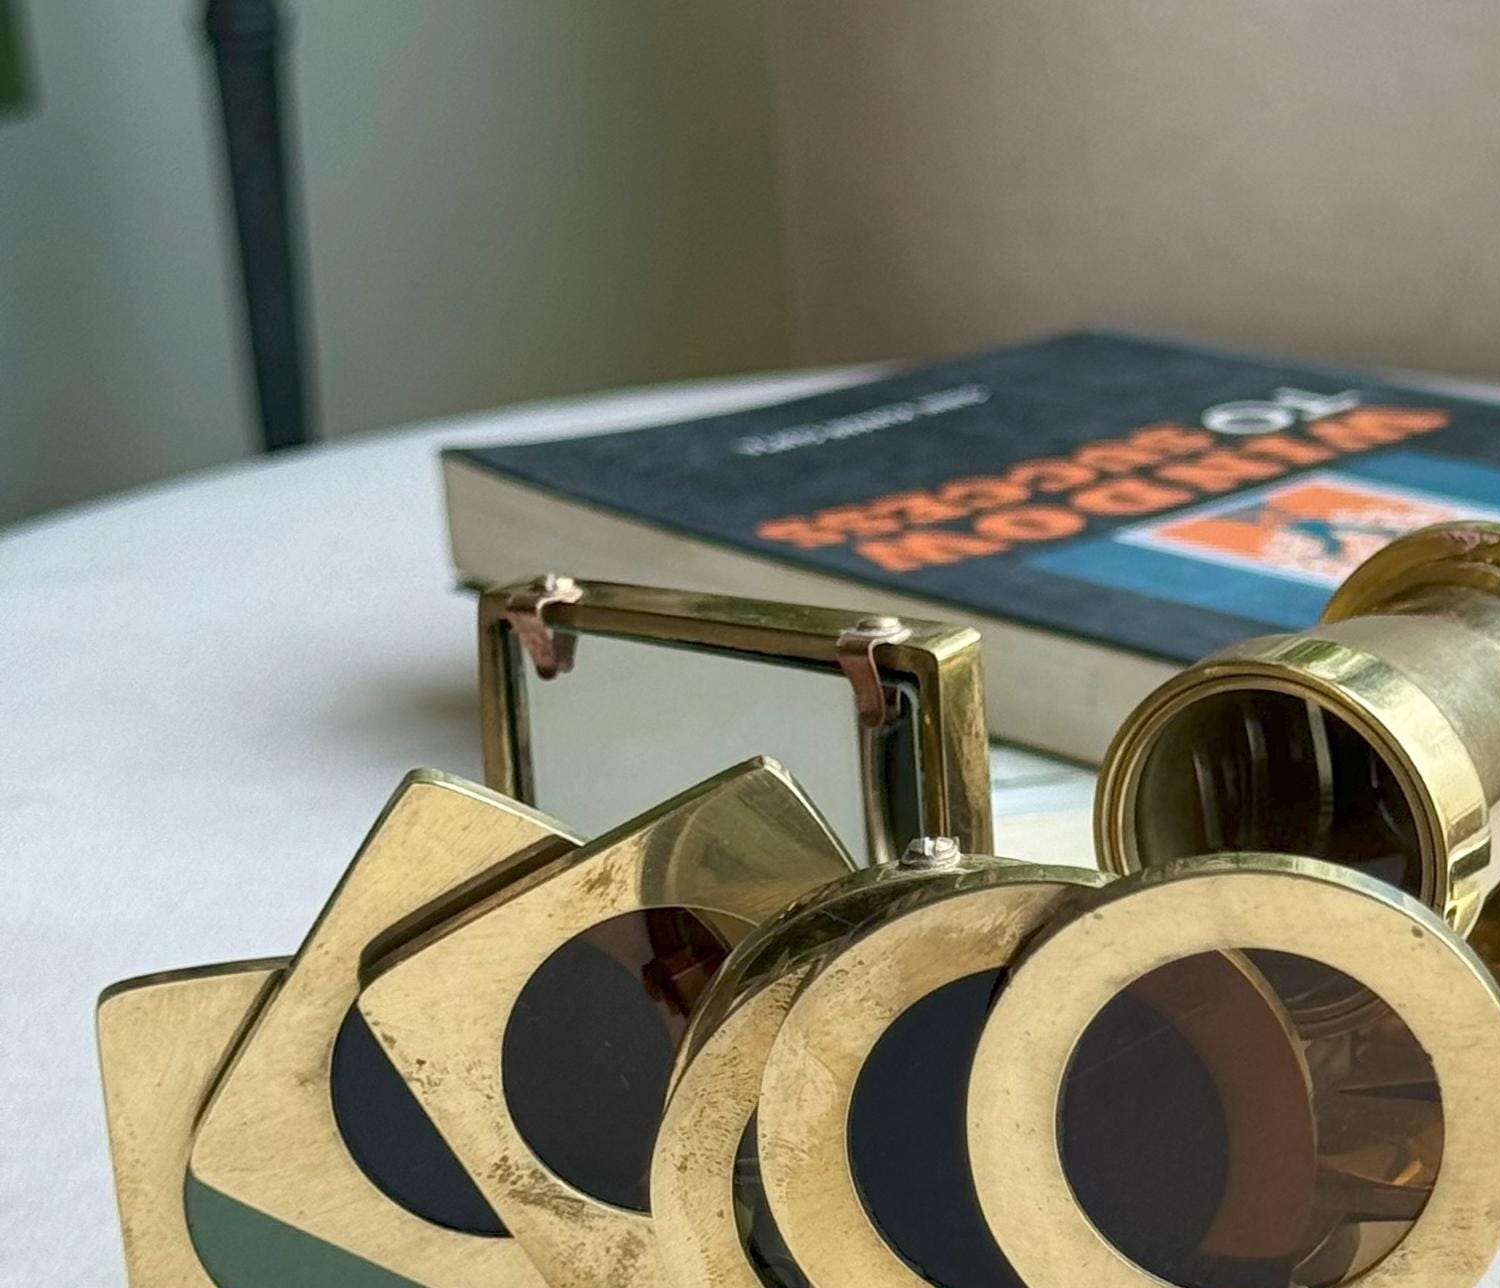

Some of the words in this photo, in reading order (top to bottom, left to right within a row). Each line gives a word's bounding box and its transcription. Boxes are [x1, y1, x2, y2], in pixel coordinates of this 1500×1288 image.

[1202, 386, 1361, 436] TO
[755, 421, 1216, 549] SUCCESS
[853, 405, 1451, 572] WINDOW
